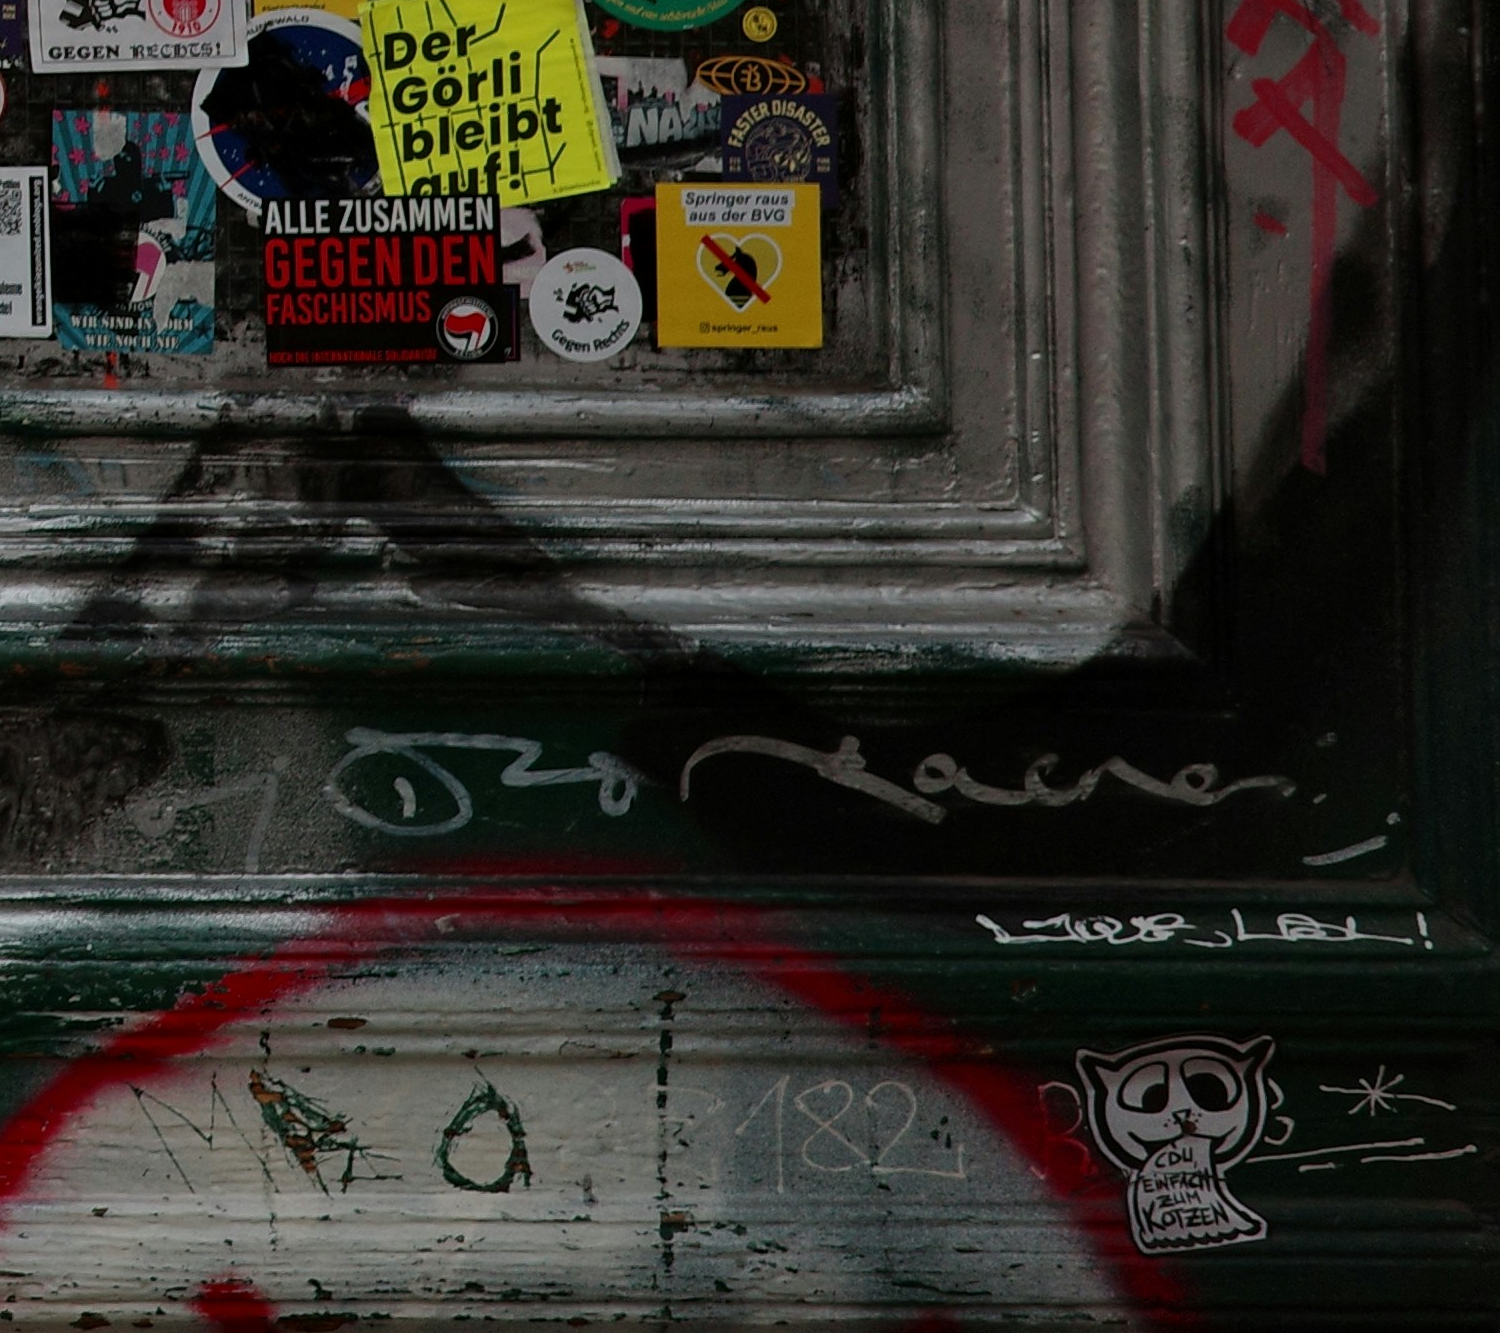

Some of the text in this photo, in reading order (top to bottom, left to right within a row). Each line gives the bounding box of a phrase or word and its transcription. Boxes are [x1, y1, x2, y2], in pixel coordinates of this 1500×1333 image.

[48, 42, 221, 59] GEGEN RECHTS!
[684, 191, 789, 208] Springer raus
[265, 196, 494, 235] ALLE ZUSAMMEN
[689, 207, 786, 223] aus der BVG
[265, 235, 497, 289] GEGEN DEN
[266, 290, 432, 326] FASCHISMUS
